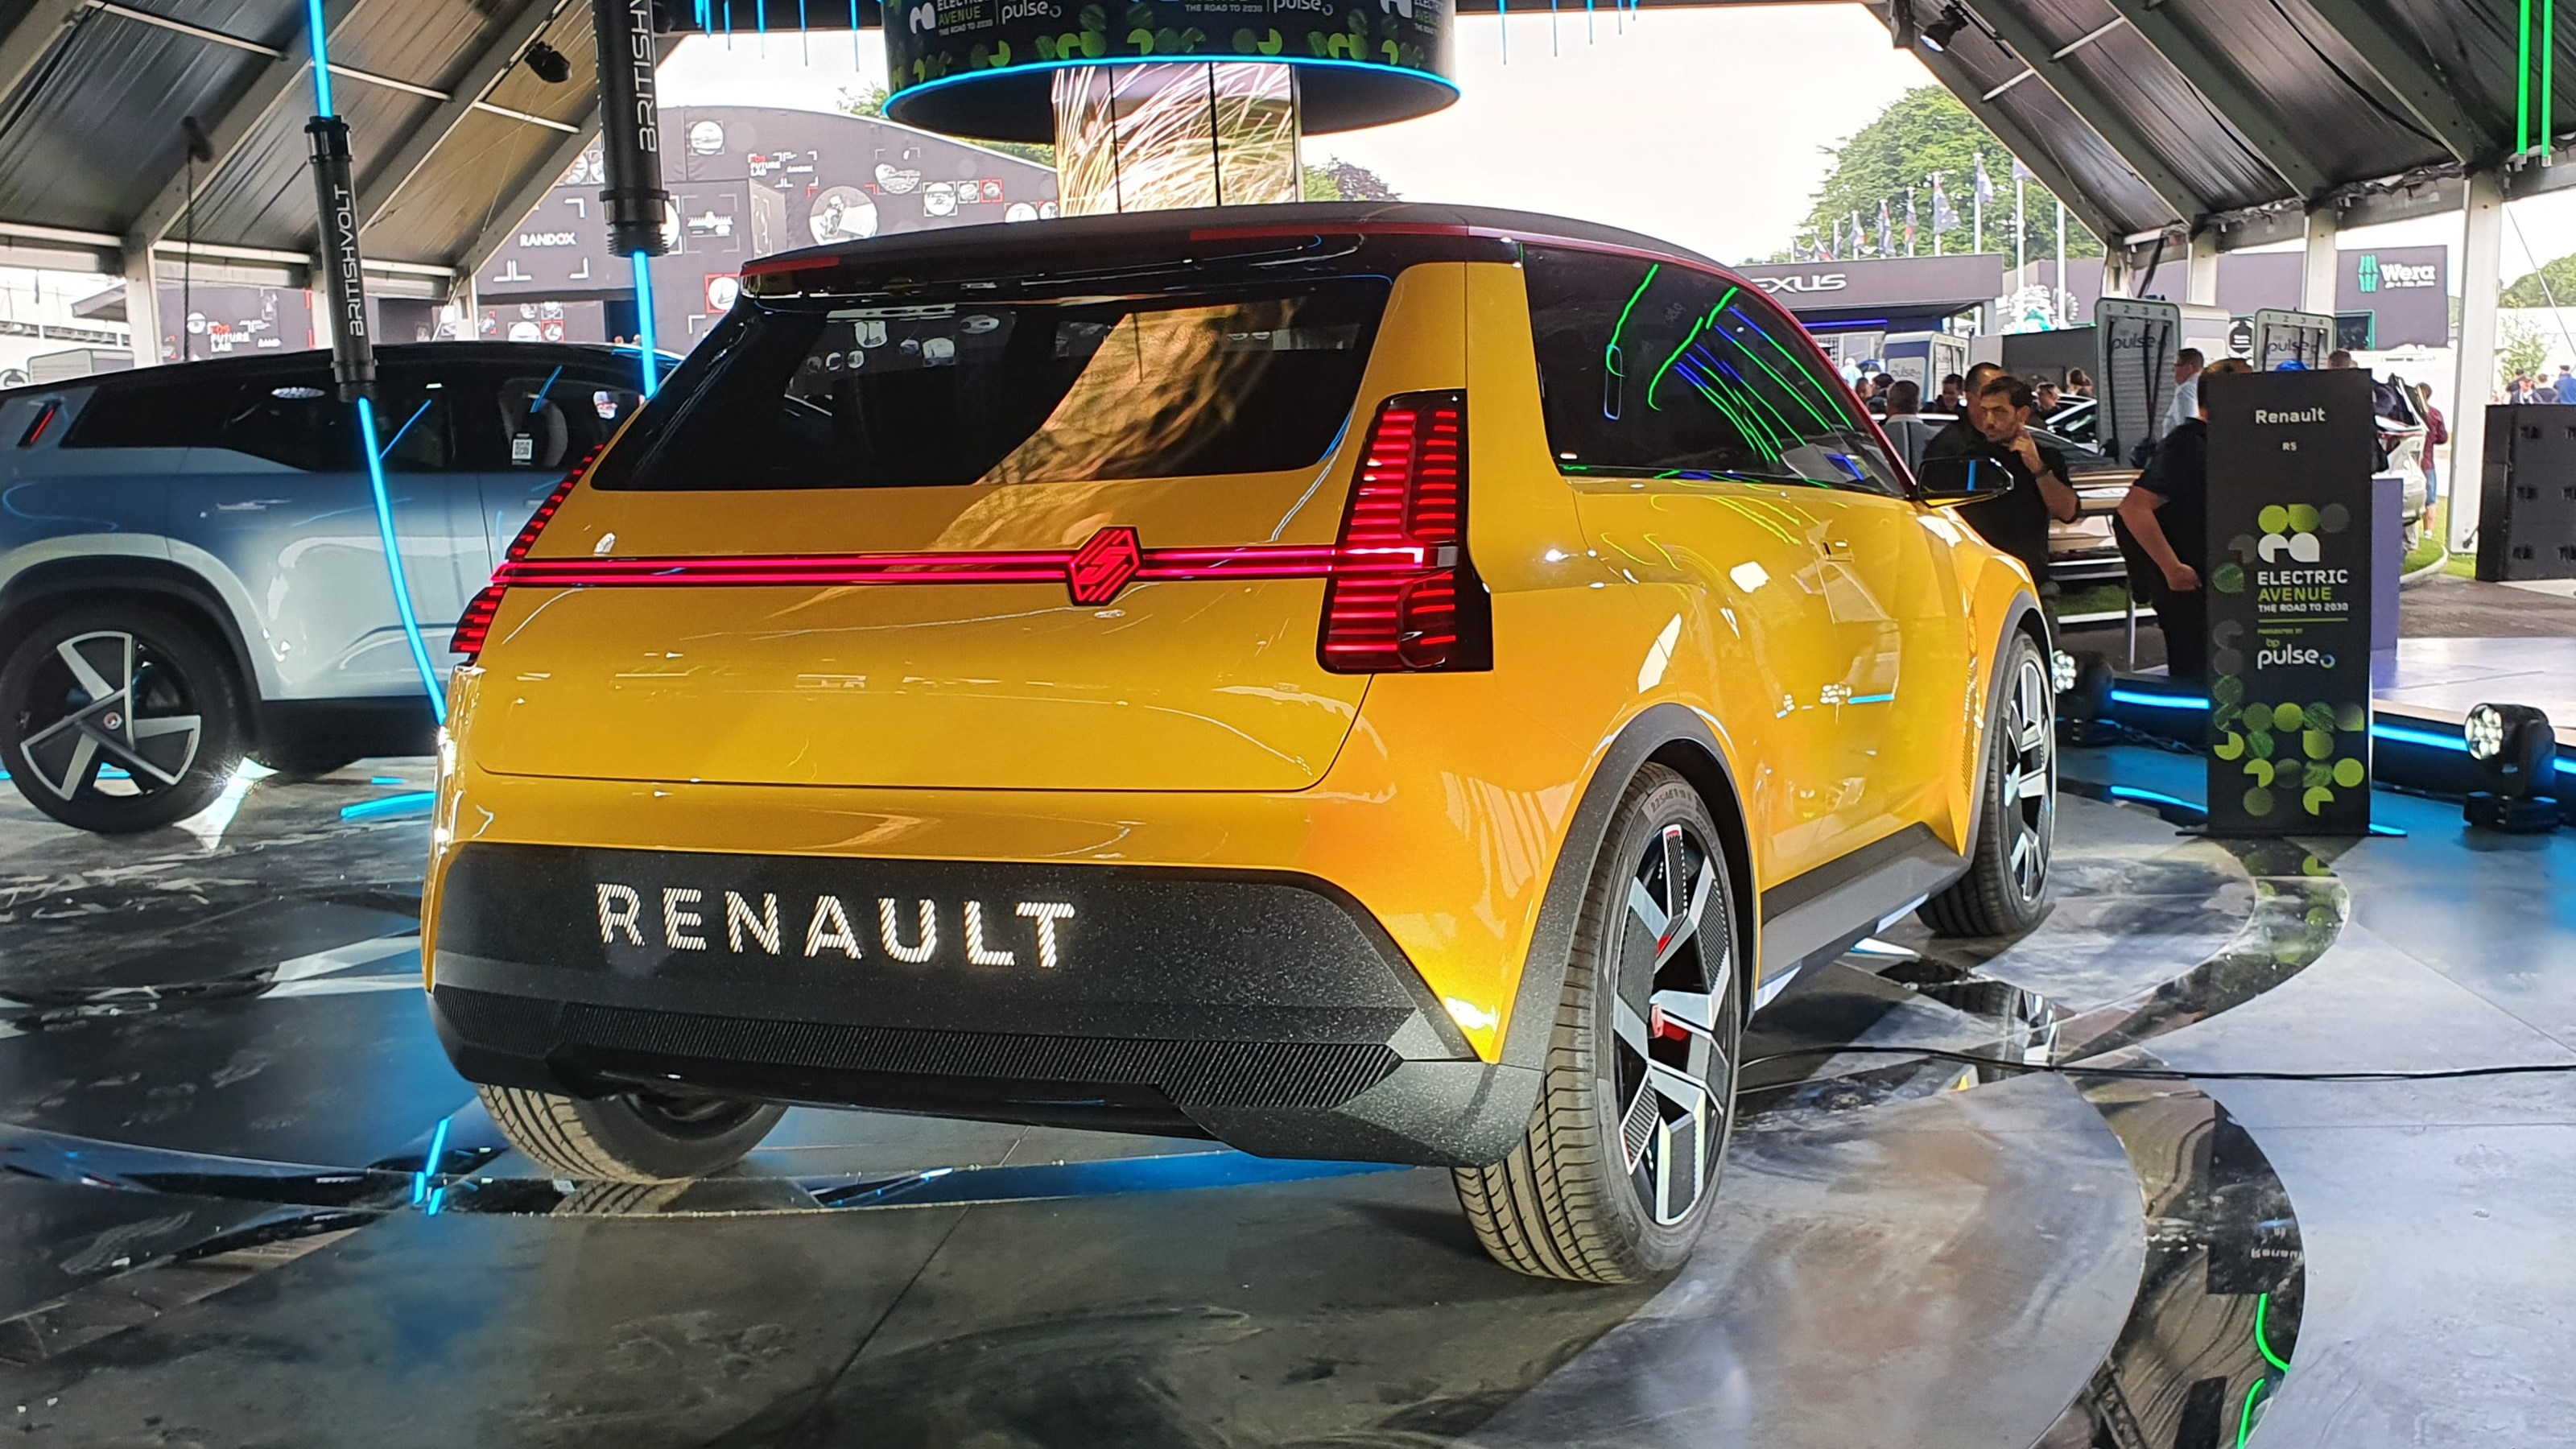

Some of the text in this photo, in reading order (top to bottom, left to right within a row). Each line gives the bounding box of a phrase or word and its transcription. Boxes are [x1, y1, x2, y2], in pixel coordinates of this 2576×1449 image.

[939, 6, 980, 26] AVENUE
[1001, 0, 1048, 24] pulse
[630, 0, 657, 152] BRITISH
[520, 232, 576, 247] RANDOX
[334, 184, 364, 336] BRITISHVOLT
[2380, 264, 2436, 281] Wera
[1750, 274, 1847, 294] EXUS
[2124, 305, 2130, 314] 2
[2142, 308, 2149, 316] 3
[2256, 407, 2326, 424] Renault
[2257, 569, 2348, 585] ELECTRIC
[2257, 587, 2332, 602] AVENUE
[2258, 602, 2349, 613] THE ROAD TO 2030
[2265, 638, 2281, 648] bp
[2257, 643, 2319, 670] pulse
[597, 882, 1075, 968] RENAULT
